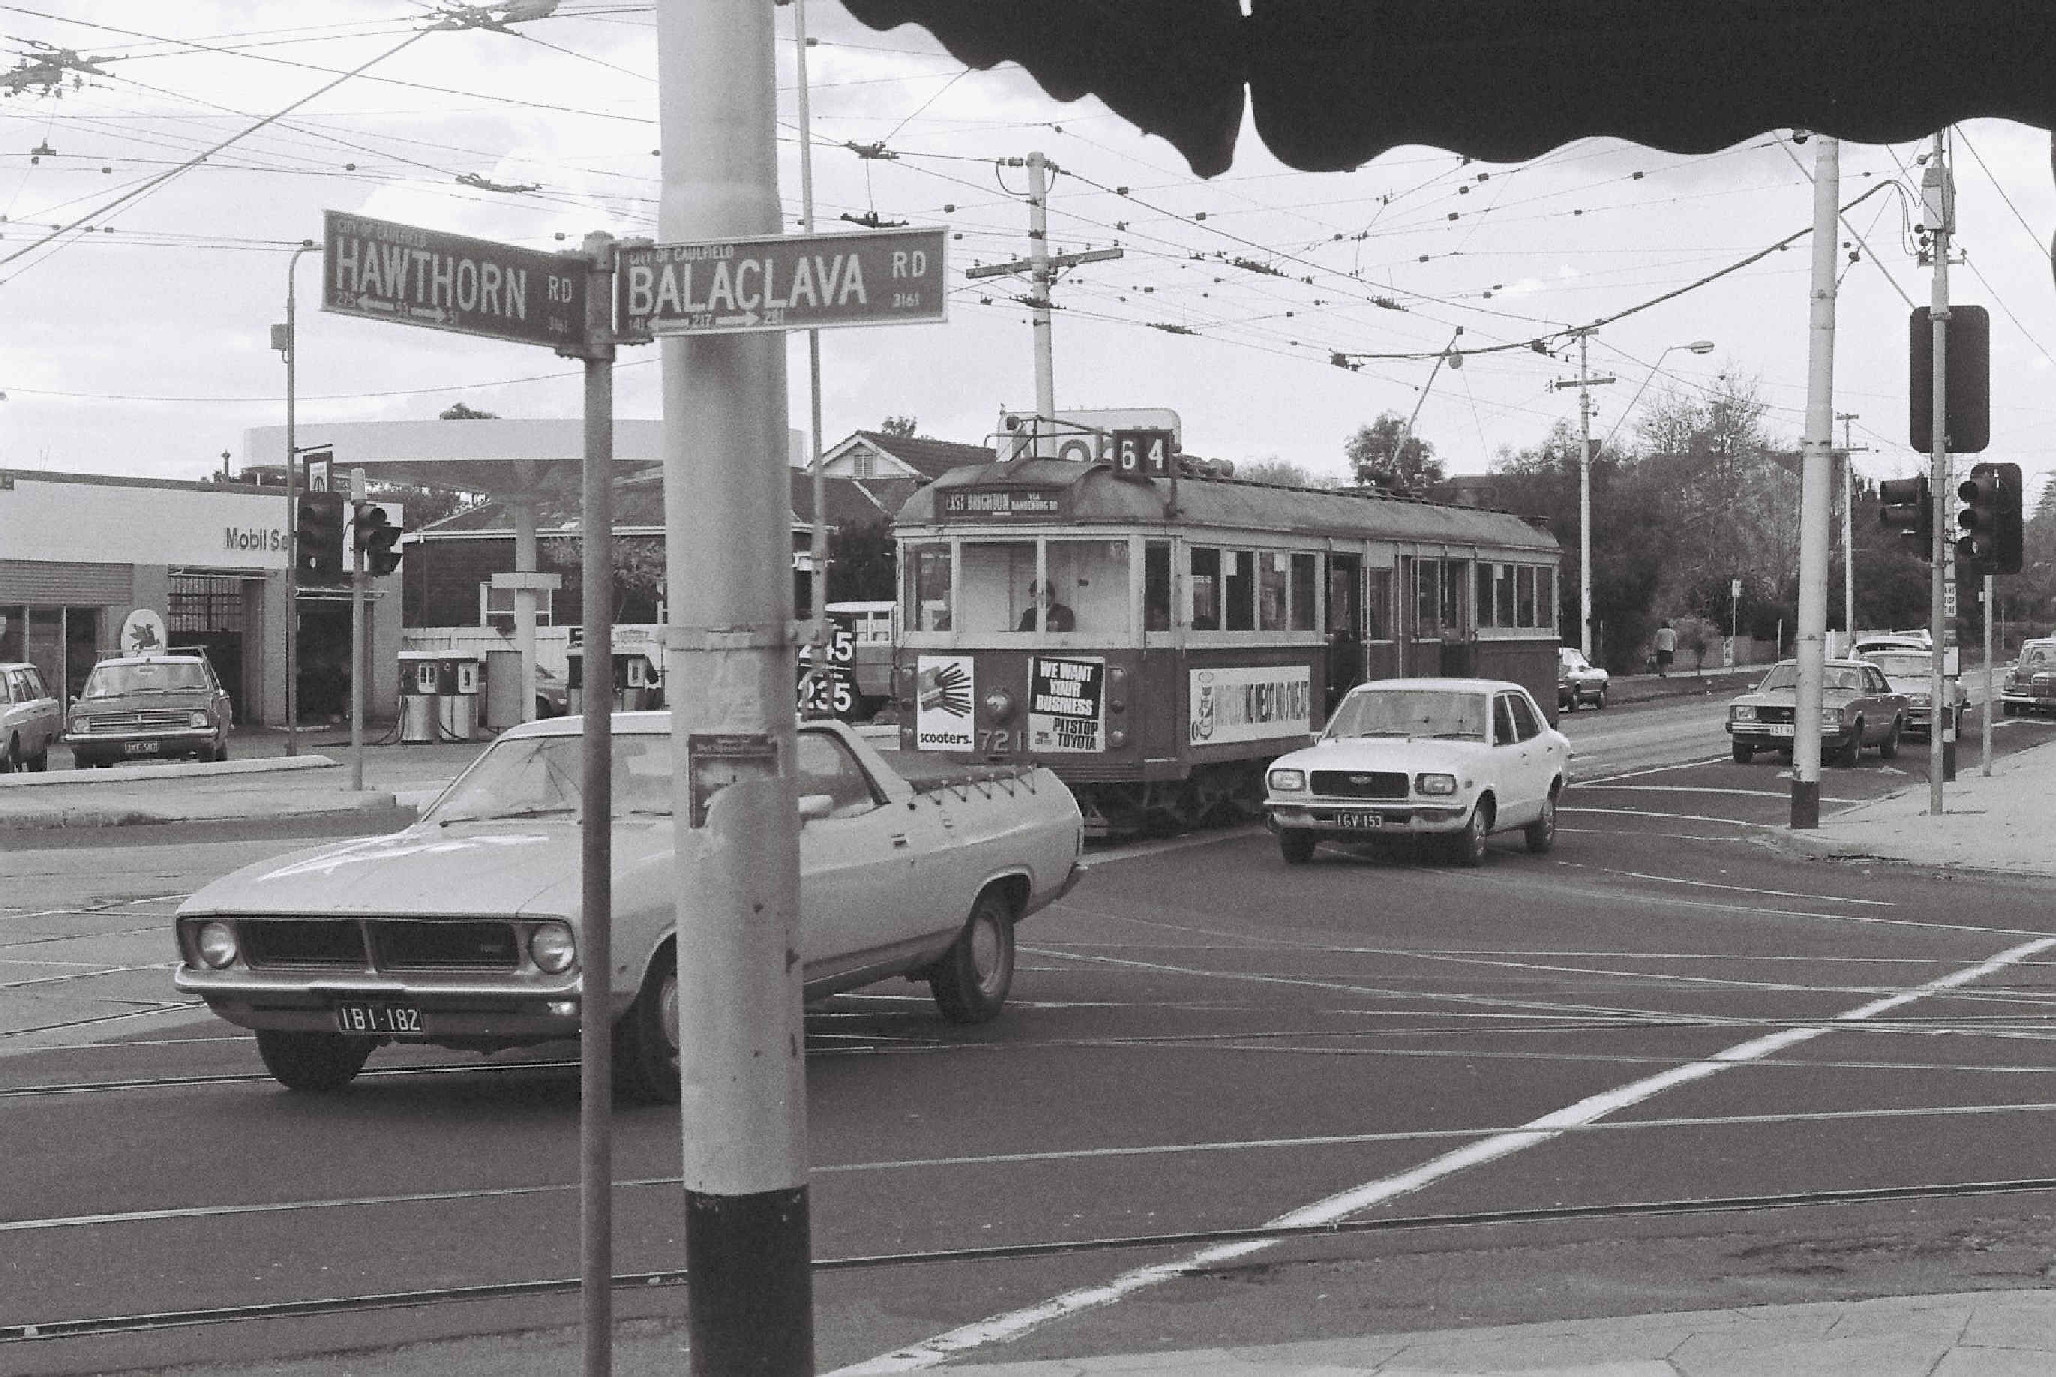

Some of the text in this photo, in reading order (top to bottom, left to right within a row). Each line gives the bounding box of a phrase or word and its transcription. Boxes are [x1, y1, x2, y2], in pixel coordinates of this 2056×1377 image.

[336, 236, 572, 319] HAWTHORN RD
[628, 250, 927, 315] BALACLAVA RD
[226, 527, 267, 550] Mobil
[1040, 660, 1094, 682] WE WANT
[1036, 694, 1093, 716] BUSINESS
[980, 729, 1022, 751] 721
